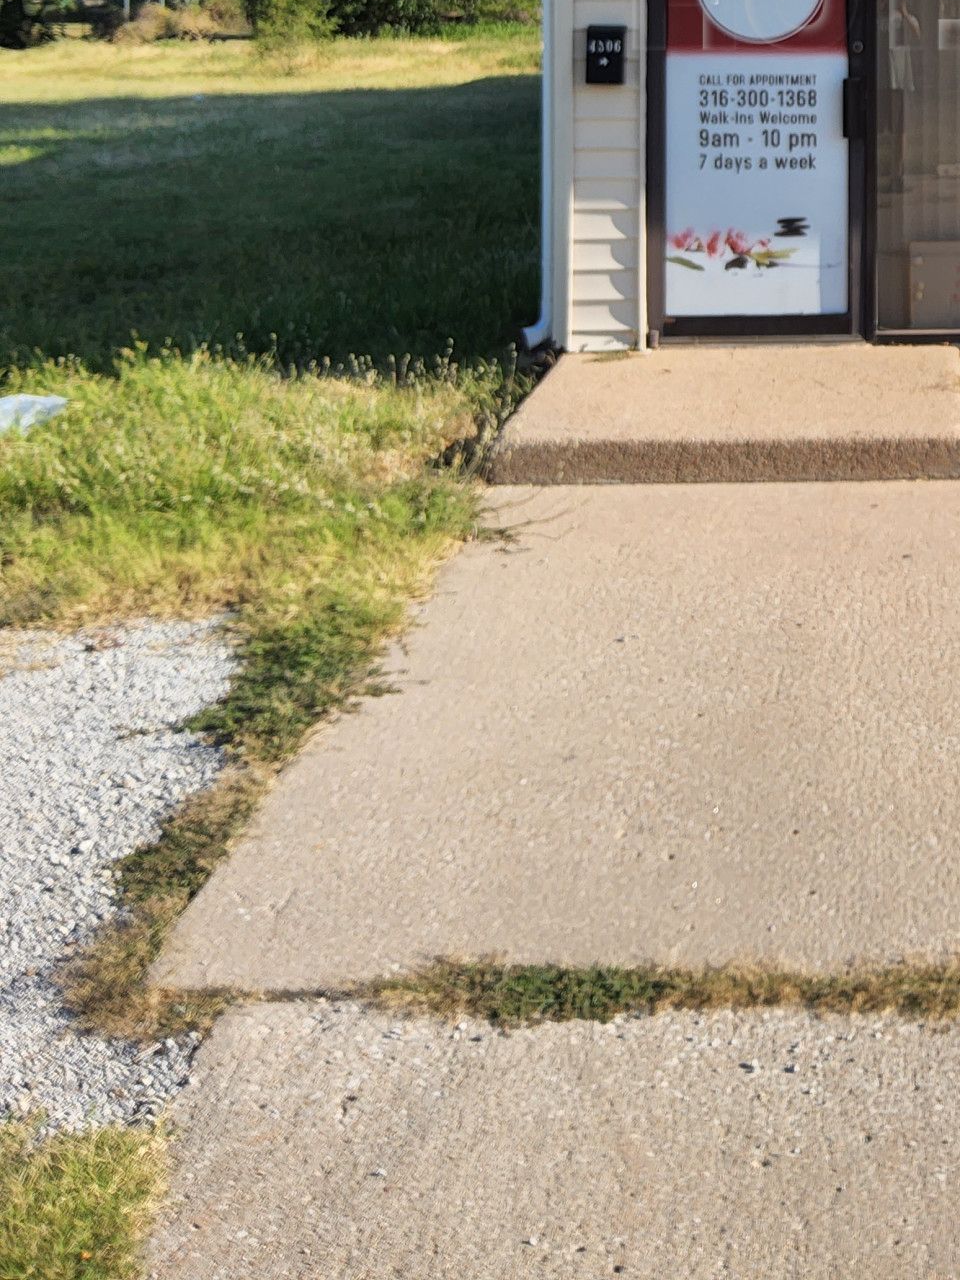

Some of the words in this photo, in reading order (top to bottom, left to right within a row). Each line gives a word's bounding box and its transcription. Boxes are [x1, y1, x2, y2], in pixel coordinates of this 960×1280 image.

[699, 74, 723, 86] CALL
[726, 74, 746, 86] FOR
[749, 74, 817, 86] APPOINTMENT
[699, 89, 817, 108] 316-300-1368
[699, 111, 754, 125] Walk-Ins
[759, 111, 818, 125] Welcome
[699, 129, 740, 148] 9am
[761, 129, 781, 148] 10
[788, 132, 817, 152] pm
[699, 153, 707, 170] 7
[714, 153, 752, 174] days
[758, 157, 768, 170] a
[775, 153, 817, 170] week
